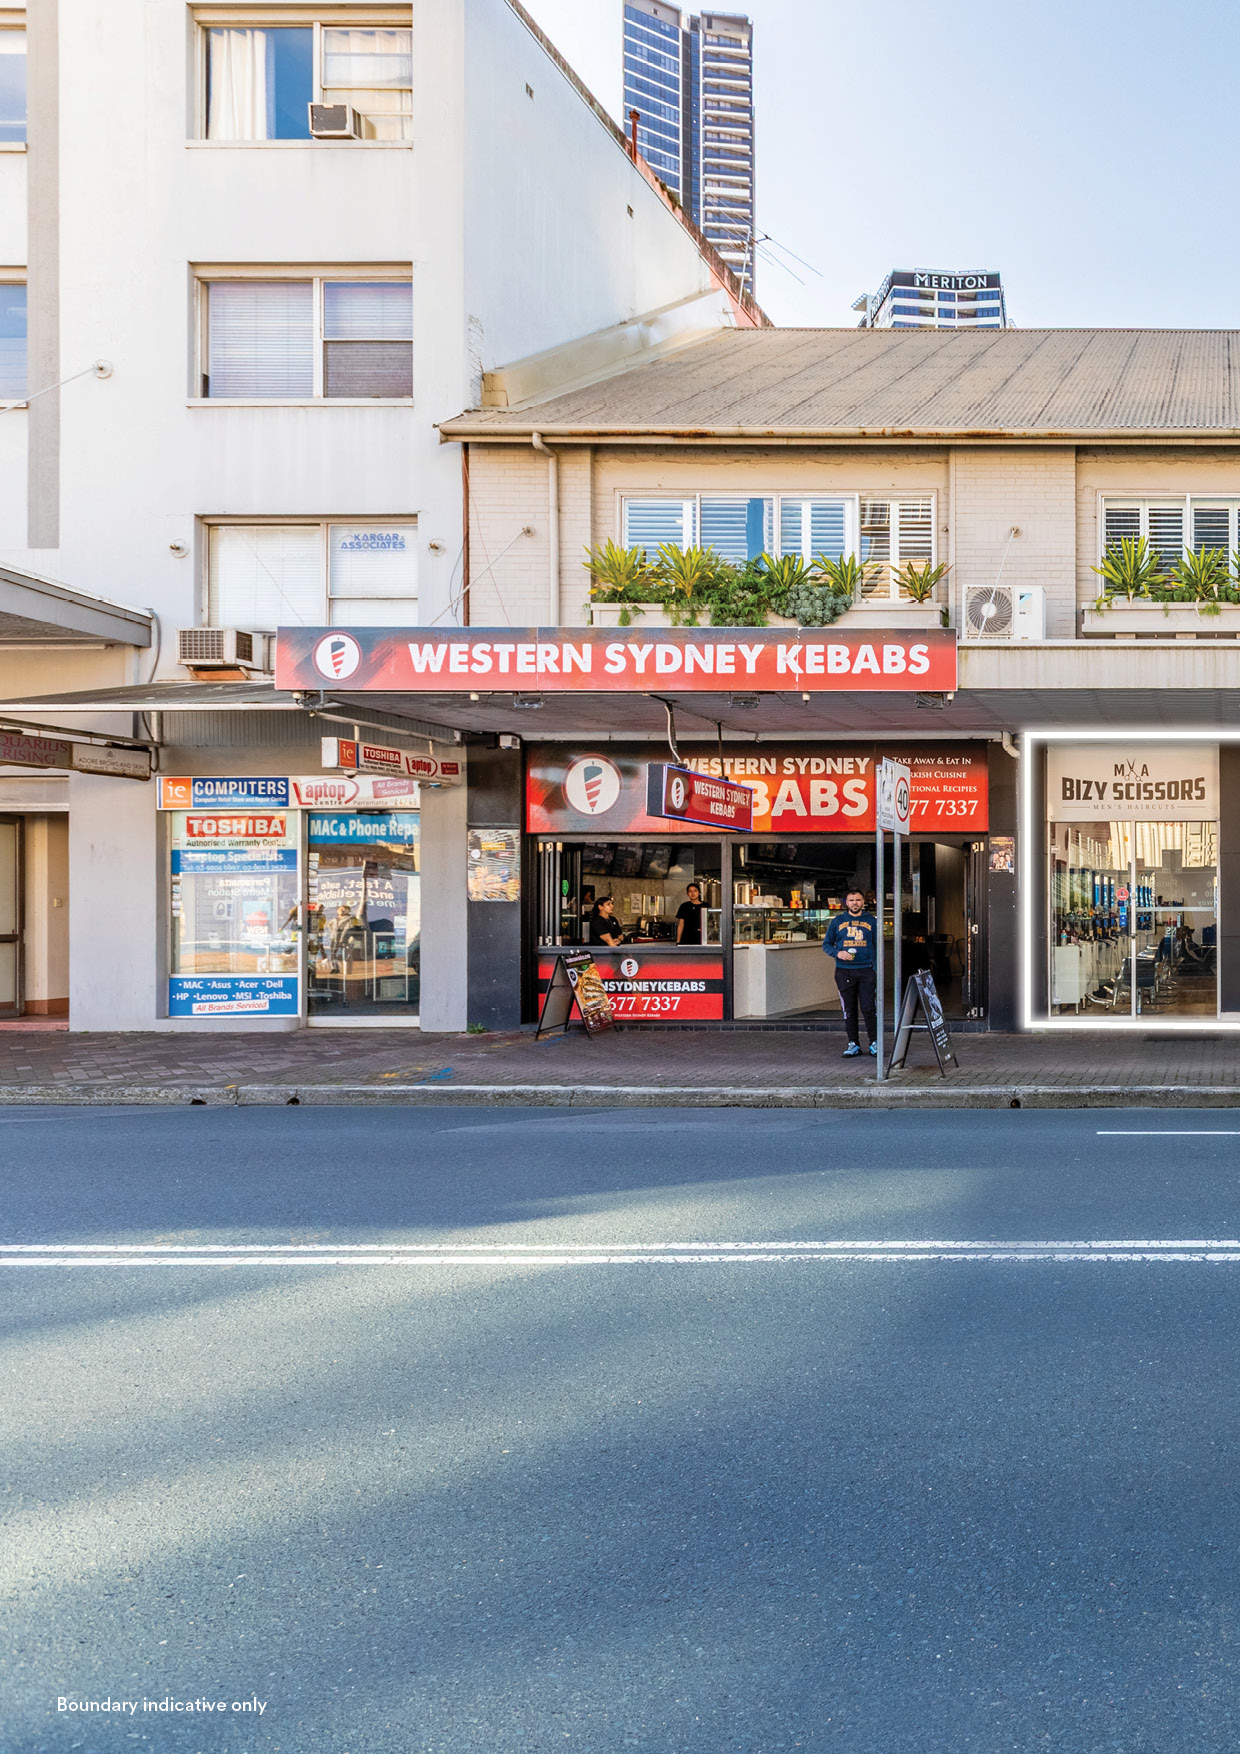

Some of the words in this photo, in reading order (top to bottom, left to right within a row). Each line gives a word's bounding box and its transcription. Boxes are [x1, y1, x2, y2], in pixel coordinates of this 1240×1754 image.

[915, 273, 987, 289] MERITON
[408, 644, 592, 674] WESTERN
[604, 644, 764, 674] SYDNEY
[778, 644, 930, 675] KEBABS
[0, 735, 68, 752] QUARIUS
[2, 748, 56, 764] RISING
[364, 748, 400, 762] TOSHIBA
[681, 758, 777, 775] WESTERN
[783, 758, 870, 775] SYDNEY
[1114, 764, 1124, 776] M
[1141, 764, 1149, 776] A
[194, 781, 286, 795] COMPUTERS
[387, 780, 409, 788] Brands
[1062, 777, 1108, 800] BIZY
[1112, 777, 1205, 800] SCISSORS
[382, 788, 408, 796] Serviced
[694, 781, 726, 799] WESTERN
[726, 788, 750, 807] SYDNEY
[752, 779, 869, 817] BABS
[897, 788, 908, 811] 40
[710, 801, 736, 819] KEBABS
[910, 800, 929, 816] 77
[935, 800, 978, 816] 7337
[188, 820, 283, 834] TOSHIBA
[310, 820, 338, 836] MAC
[340, 824, 346, 835] &
[348, 820, 387, 836] Phone
[390, 820, 419, 839] Repa
[187, 839, 225, 847] Authorised
[228, 839, 260, 848] Warranty
[266, 980, 283, 988] Dell
[604, 982, 706, 992] NSYDNEYKEBABS
[236, 992, 252, 1000] MSI
[259, 992, 292, 1000] Toshiba
[608, 996, 636, 1011] 677
[641, 996, 680, 1011] 7337
[196, 1004, 206, 1012] All
[208, 1002, 234, 1011] Brands
[236, 1001, 267, 1009] Serviced
